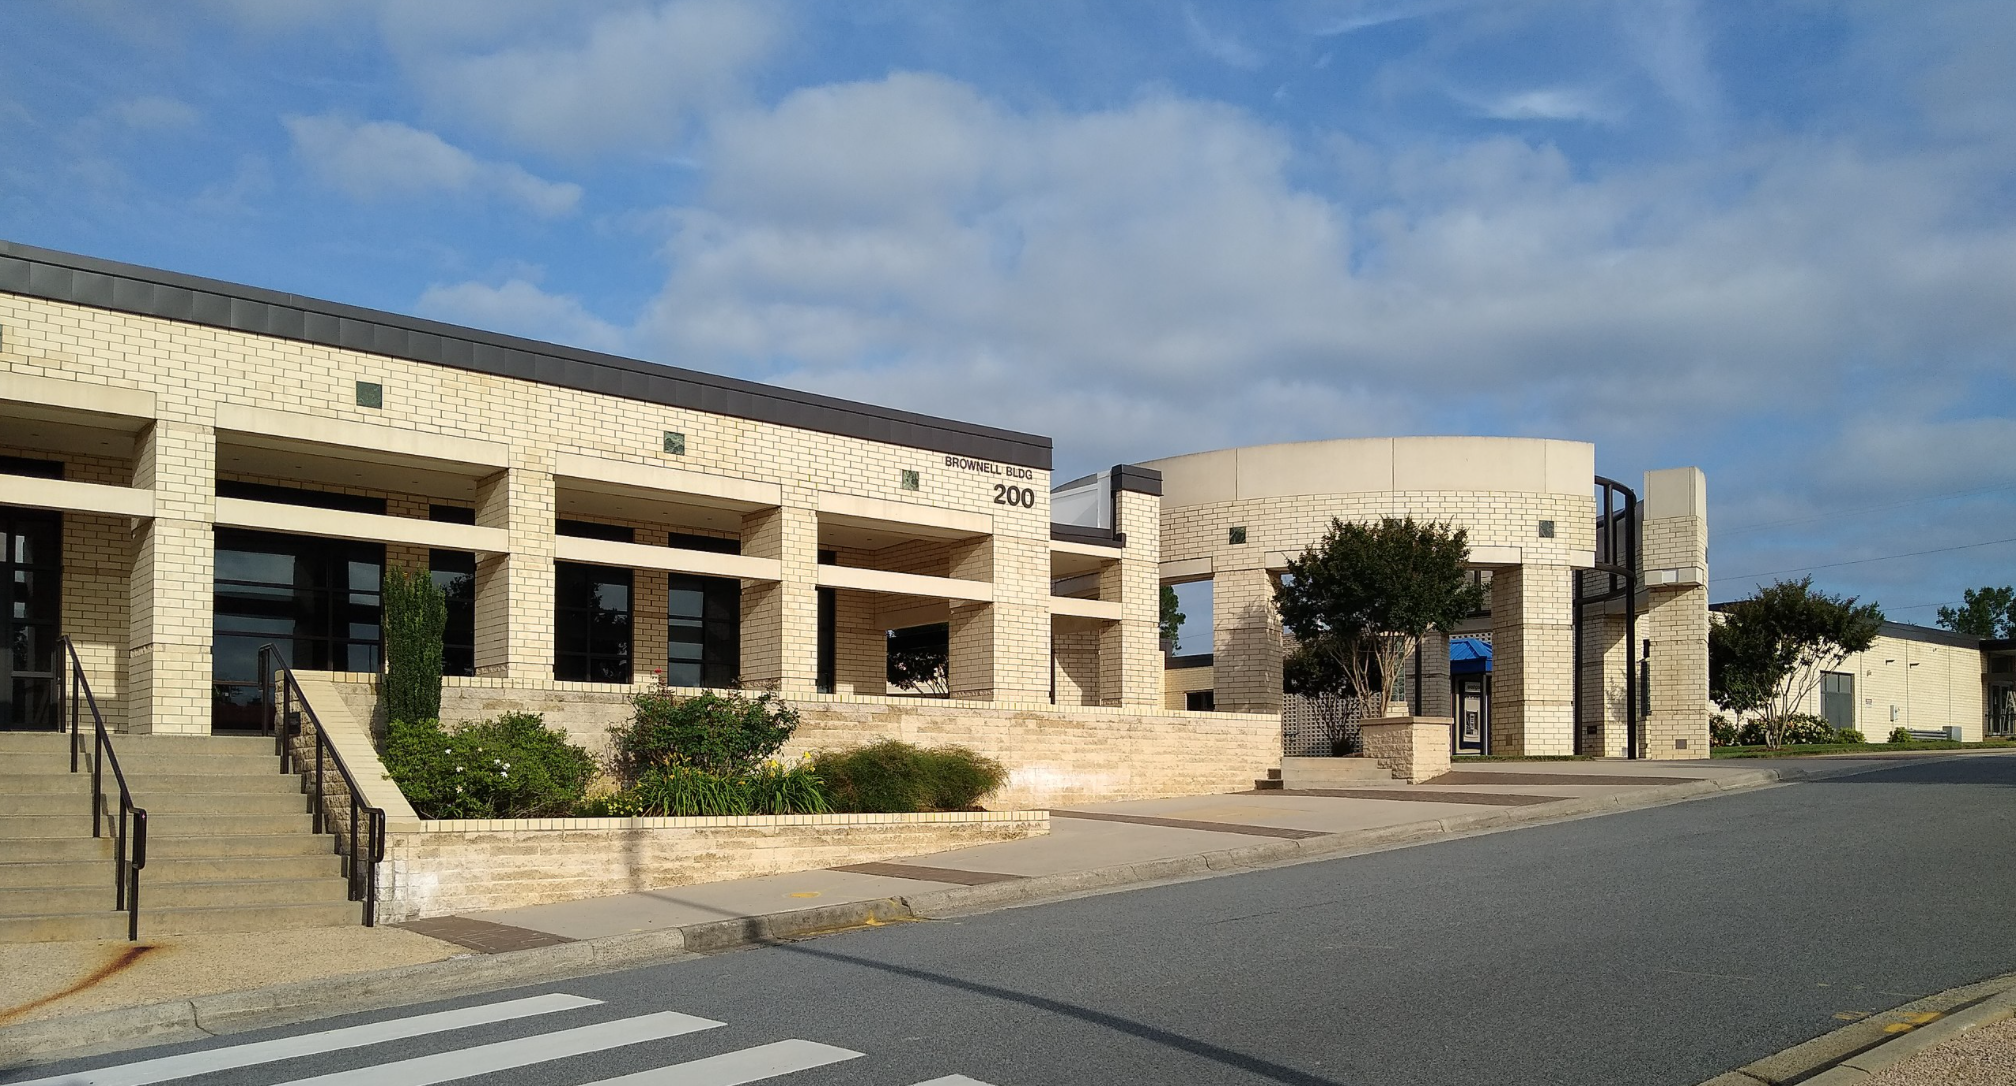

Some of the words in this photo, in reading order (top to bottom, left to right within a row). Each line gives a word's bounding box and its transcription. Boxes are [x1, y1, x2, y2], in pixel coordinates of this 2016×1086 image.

[945, 456, 1002, 475] BROWNELL
[1006, 466, 1033, 480] BLDG
[993, 484, 1035, 509] 200
